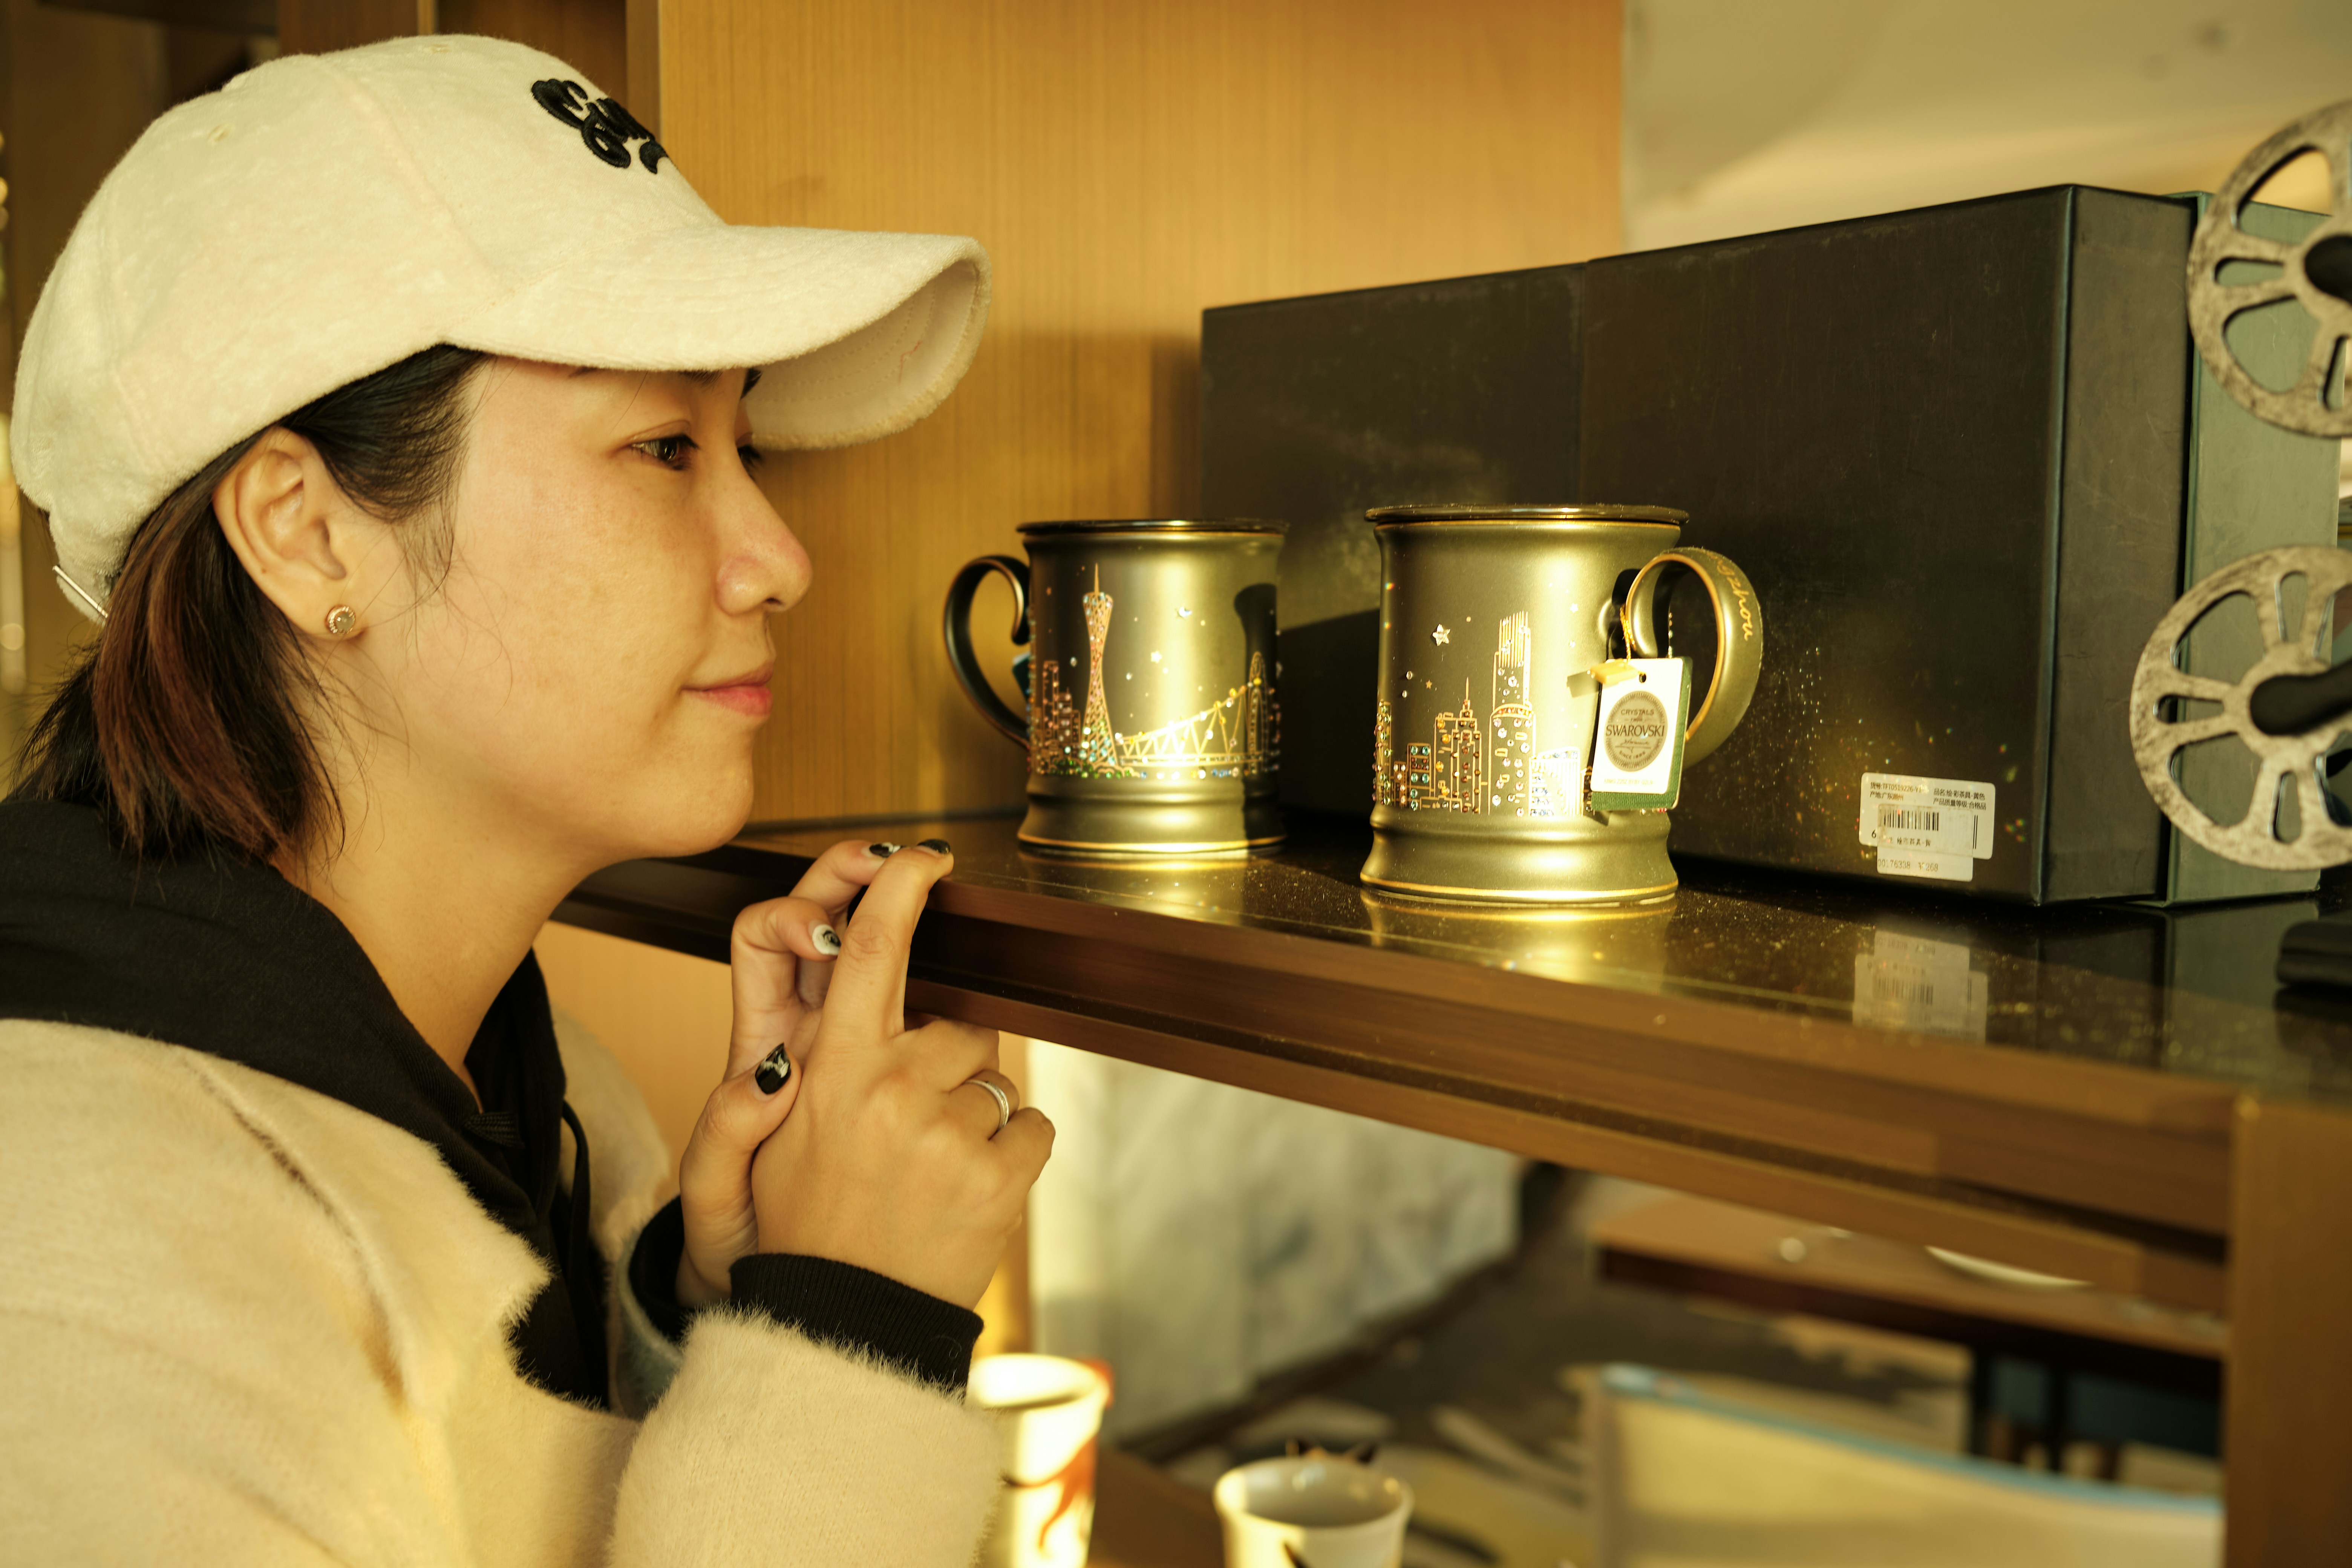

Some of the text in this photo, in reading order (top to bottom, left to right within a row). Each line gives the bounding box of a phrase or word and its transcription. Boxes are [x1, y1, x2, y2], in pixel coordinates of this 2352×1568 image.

[1606, 724, 1665, 737] SWAROVSKI
[1619, 750, 1632, 759] SINCE
[1933, 797, 1986, 810] 产品质量等级:合格品
